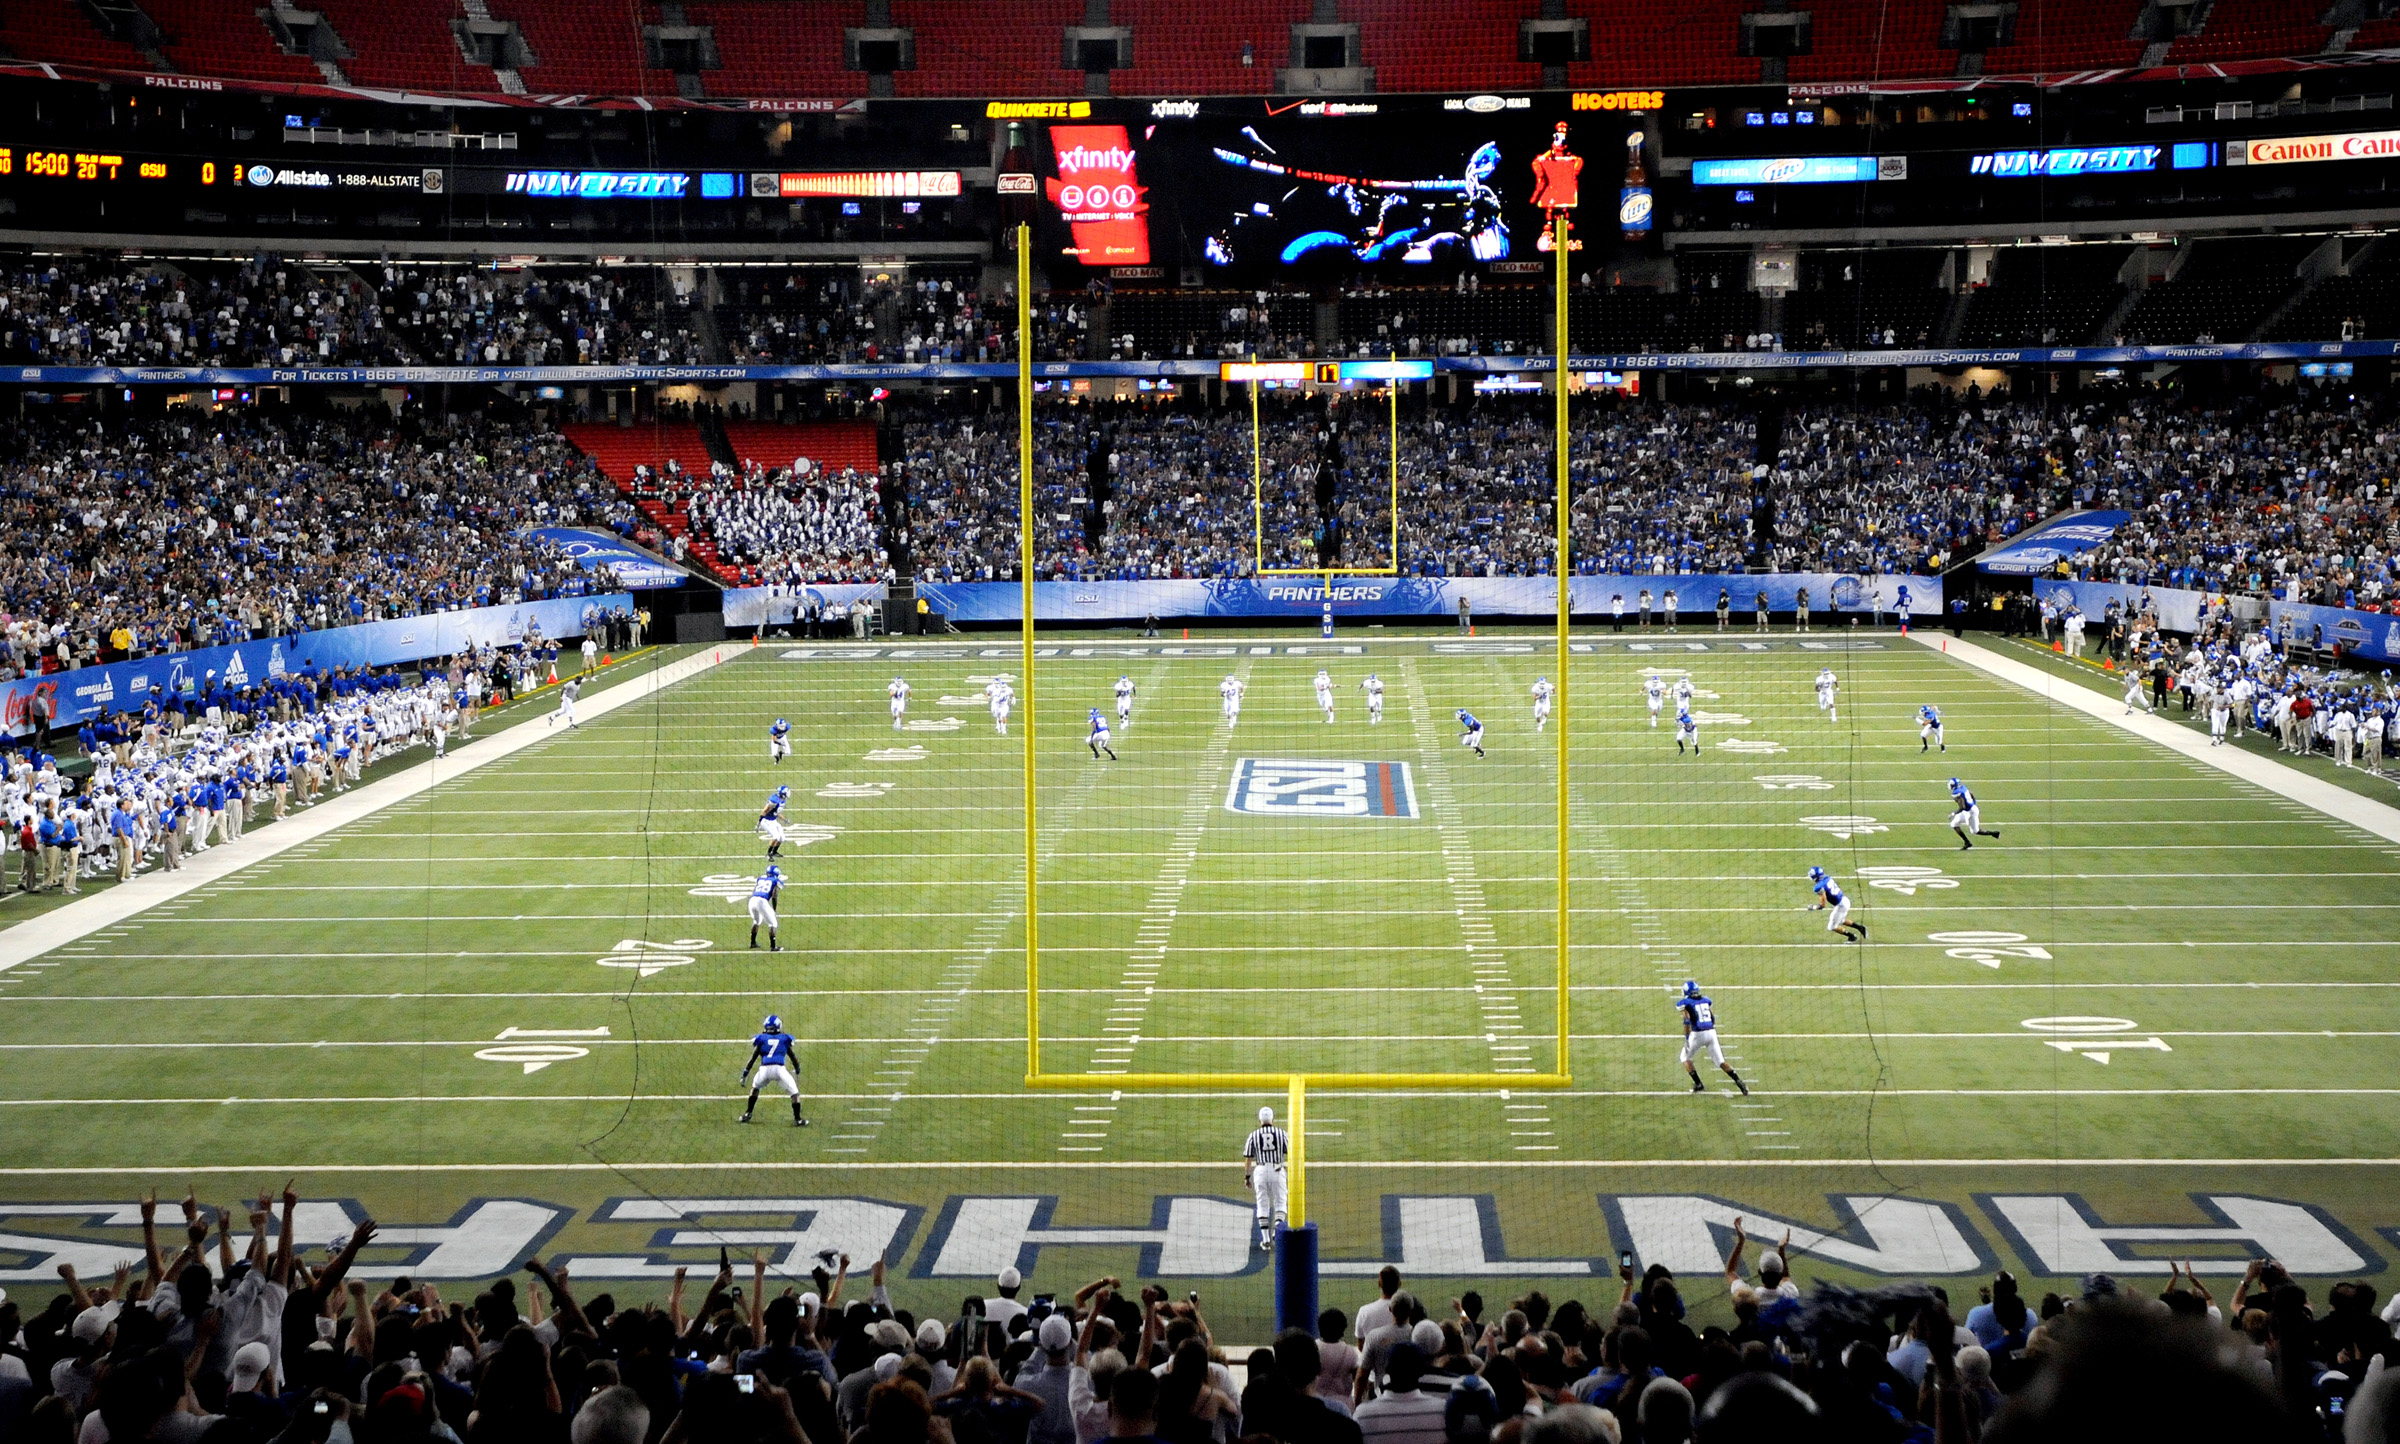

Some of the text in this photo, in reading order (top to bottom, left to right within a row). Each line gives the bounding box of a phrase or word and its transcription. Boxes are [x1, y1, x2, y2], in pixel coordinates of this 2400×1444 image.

[145, 77, 223, 91] FALCONS
[1788, 85, 1869, 96] FALCONS
[749, 100, 834, 111] FALCONS
[1300, 101, 1346, 115] verizon
[1444, 97, 1530, 110] LOCAL Ford DEALER
[1572, 91, 1664, 111] HOOTERS
[986, 102, 1068, 119] QUIKRETE
[1059, 146, 1135, 172] xfinity
[2252, 142, 2332, 162] Canon
[25, 152, 69, 176] 15:00
[139, 163, 167, 178] GSU
[77, 164, 98, 179] 20
[109, 165, 117, 180] 1
[202, 162, 215, 184] 0
[234, 164, 244, 180] 3
[1769, 162, 1801, 181] Lite
[337, 174, 420, 187] 1-888-ALLSTATE
[1000, 177, 1033, 190] Coca-Cola
[1062, 212, 1135, 221] TV INTERNET VOICE
[1113, 268, 1163, 277] TACO MAC
[1492, 263, 1543, 272] TACO MAC
[2052, 349, 2076, 359] GSU
[2165, 347, 2224, 358] PANTHERS
[2320, 344, 2342, 353] GSU
[1046, 364, 1068, 373] GSU
[1524, 358, 1551, 368] FOR
[1567, 358, 1606, 367] CKETS
[1612, 355, 1745, 367] 1-866-GA-STATE
[1750, 356, 1765, 364] OR
[1771, 355, 1801, 364] VISIT
[22, 368, 41, 379] GSU
[138, 371, 186, 380] PANTHERS
[272, 370, 296, 381] FOR
[301, 370, 348, 381] TICKETS
[352, 369, 478, 381] 1-866-GA-STATE
[484, 371, 499, 379] OR
[503, 370, 533, 379] VISIT
[1321, 363, 1339, 382] 17
[1988, 563, 2027, 571] GEORGIA
[649, 577, 677, 586] STATE
[1075, 594, 1100, 604] GSU
[1269, 586, 1383, 601] PANTHERS
[778, 645, 1368, 659] GEORGIA
[132, 676, 148, 690] GSU
[223, 671, 249, 687] adidas
[76, 683, 101, 697] GEORGIA
[93, 691, 114, 703] POWER
[98, 759, 110, 768] 12
[756, 879, 773, 894] 28
[1695, 1003, 1712, 1023] 15
[767, 1039, 781, 1058] 7
[1261, 1133, 1276, 1151] R
[0, 1197, 2400, 1279] ANTHERS
